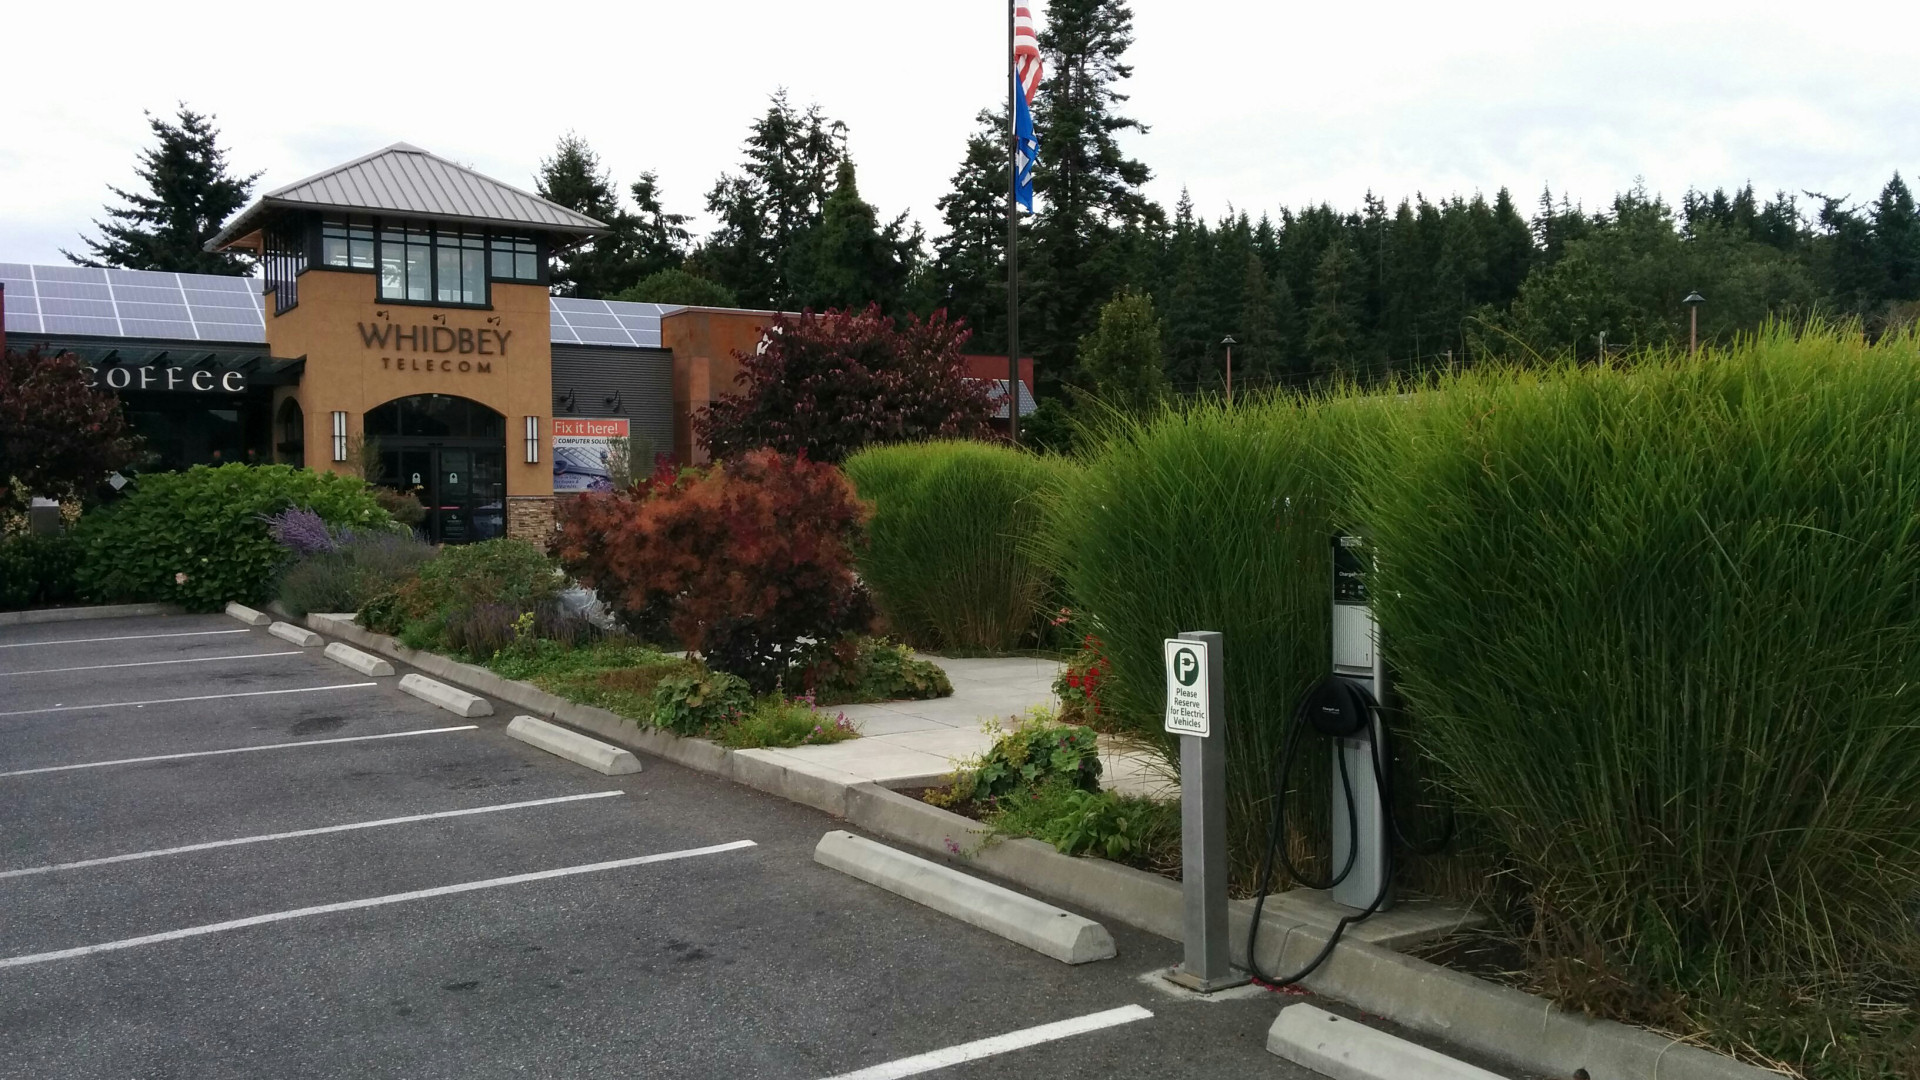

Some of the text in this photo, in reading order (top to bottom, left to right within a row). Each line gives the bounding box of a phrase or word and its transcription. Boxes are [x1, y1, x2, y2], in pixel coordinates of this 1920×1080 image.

[357, 322, 512, 356] WHIDBEY
[382, 357, 492, 373] TELECOM
[555, 421, 618, 434] Fix it here!
[1176, 687, 1198, 699] Please
[1174, 697, 1200, 709] Reserve
[1170, 706, 1205, 719] for Electric
[1173, 716, 1201, 728] Vehicles
